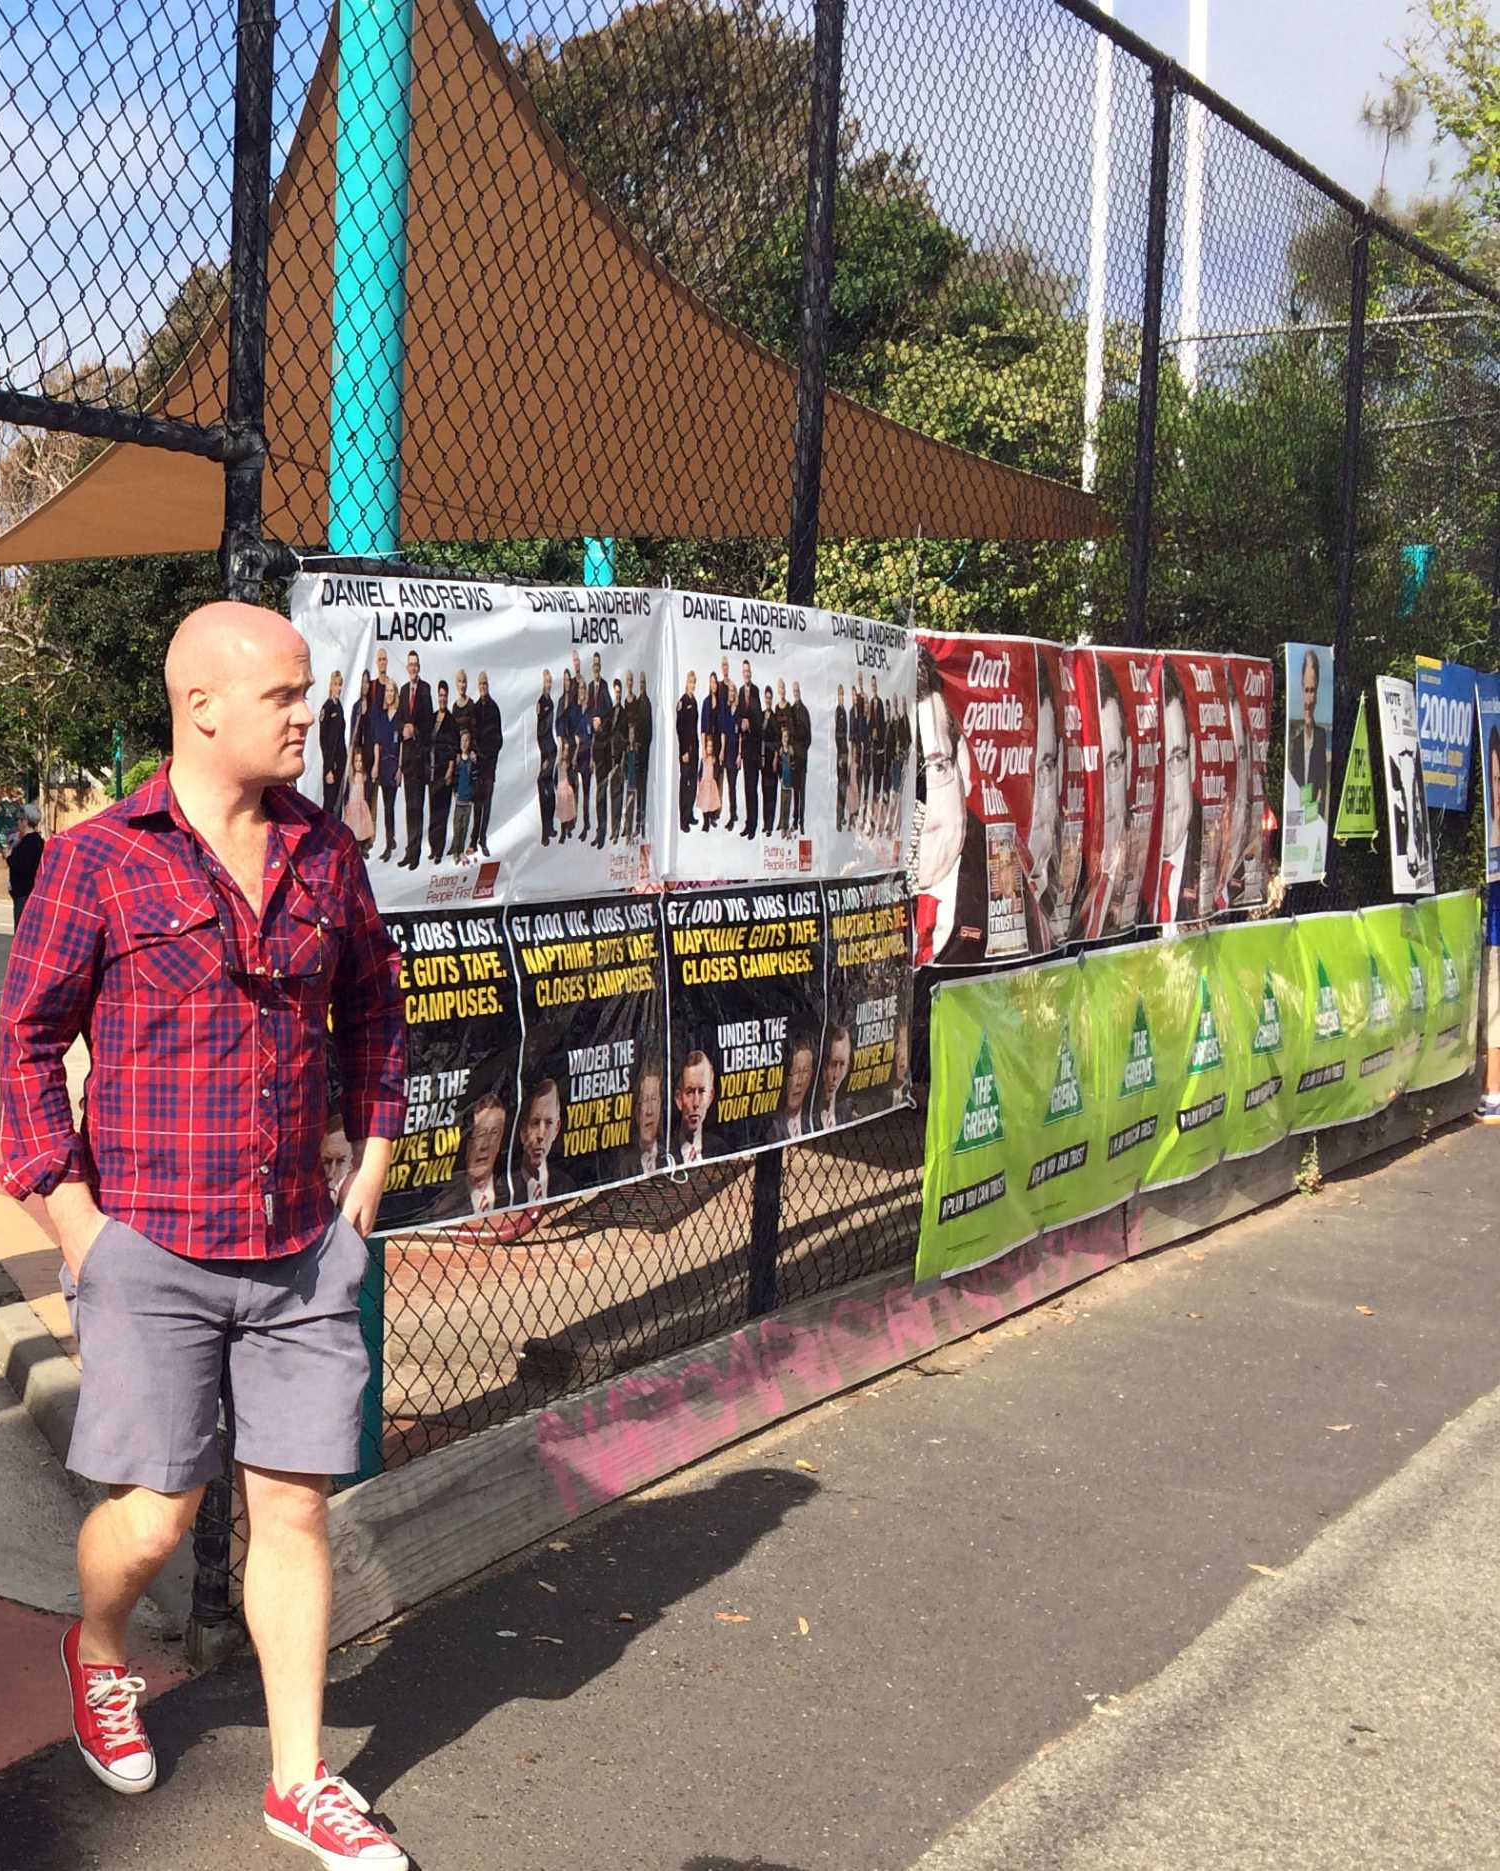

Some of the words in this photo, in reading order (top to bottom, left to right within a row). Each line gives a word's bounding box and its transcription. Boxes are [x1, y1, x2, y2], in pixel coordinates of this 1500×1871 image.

[321, 579, 394, 607] DANIEL
[399, 583, 493, 612] ANDREWS
[525, 591, 585, 613] DANIEL
[588, 592, 651, 616] ANDREWS
[376, 611, 452, 642] LABOR.
[570, 616, 624, 644] LABOR.
[683, 596, 736, 623] DANIEL
[741, 603, 806, 631] ANDREWS
[719, 625, 775, 654] LABOR.
[832, 615, 866, 641] DANIEL
[867, 625, 906, 650] ANDREWS
[855, 644, 891, 671] LABOR.
[967, 651, 1011, 689] Don't
[1384, 691, 1402, 706] VOTE
[963, 694, 1023, 738] gamble
[1421, 693, 1472, 750] 200,000
[974, 738, 998, 774] ith
[997, 746, 1033, 783] your
[512, 914, 563, 945] 67,000
[565, 909, 589, 938] VIC
[592, 907, 625, 935] JOBS
[626, 903, 657, 932] LOST.
[667, 900, 722, 928] 67,000
[726, 898, 749, 923] VIC
[752, 895, 786, 920] JOBS
[788, 892, 820, 915] LOST.
[990, 915, 1013, 933] TRUST
[411, 922, 456, 952] JOBS
[457, 918, 503, 948] LOST.
[673, 926, 746, 956] NAPTHINE
[749, 924, 786, 948] GUTS
[788, 919, 820, 943] TAFE.
[414, 955, 460, 986] GUTS
[460, 951, 507, 981] TAFE.
[521, 942, 593, 974] NAPTHINE
[596, 938, 625, 965] GUTS
[626, 933, 659, 961] TAFE.
[683, 956, 738, 985] CLOSES
[739, 949, 814, 979] CAMPUSES.
[536, 976, 585, 1007] CLOSES
[587, 965, 655, 999] CAMPUSES.
[405, 986, 503, 1024] CAMPUSES.
[856, 999, 882, 1025] UNDER
[718, 1019, 761, 1048] UNDER
[763, 1016, 789, 1040] THE
[857, 1018, 895, 1048] LIBERALS
[1133, 1030, 1148, 1057] THE
[568, 1044, 612, 1076] UNDER
[613, 1039, 635, 1066] THE
[723, 1042, 783, 1073] LIBERALS
[437, 1068, 470, 1099] THE
[570, 1069, 630, 1103] LIBERALS
[719, 1069, 765, 1099] YOU'RE
[767, 1066, 784, 1089] ON
[974, 1074, 994, 1104] THE
[1051, 1080, 1078, 1113] GREENS
[404, 1099, 457, 1134] ERALS
[566, 1098, 613, 1130] YOU'RE
[615, 1093, 633, 1121] ON
[717, 1095, 750, 1123] YOUR
[751, 1090, 781, 1115] OWN
[964, 1104, 999, 1142] GREENS
[434, 1126, 460, 1156] ON
[563, 1126, 599, 1158] YOUR
[601, 1120, 631, 1150] OWN
[384, 1164, 411, 1192] UR
[412, 1155, 456, 1186] OWN
[948, 1194, 964, 1215] PLAN
[965, 1188, 977, 1209] YOU
[978, 1183, 990, 1205] CAN
[990, 1175, 1005, 1198] TRUST
